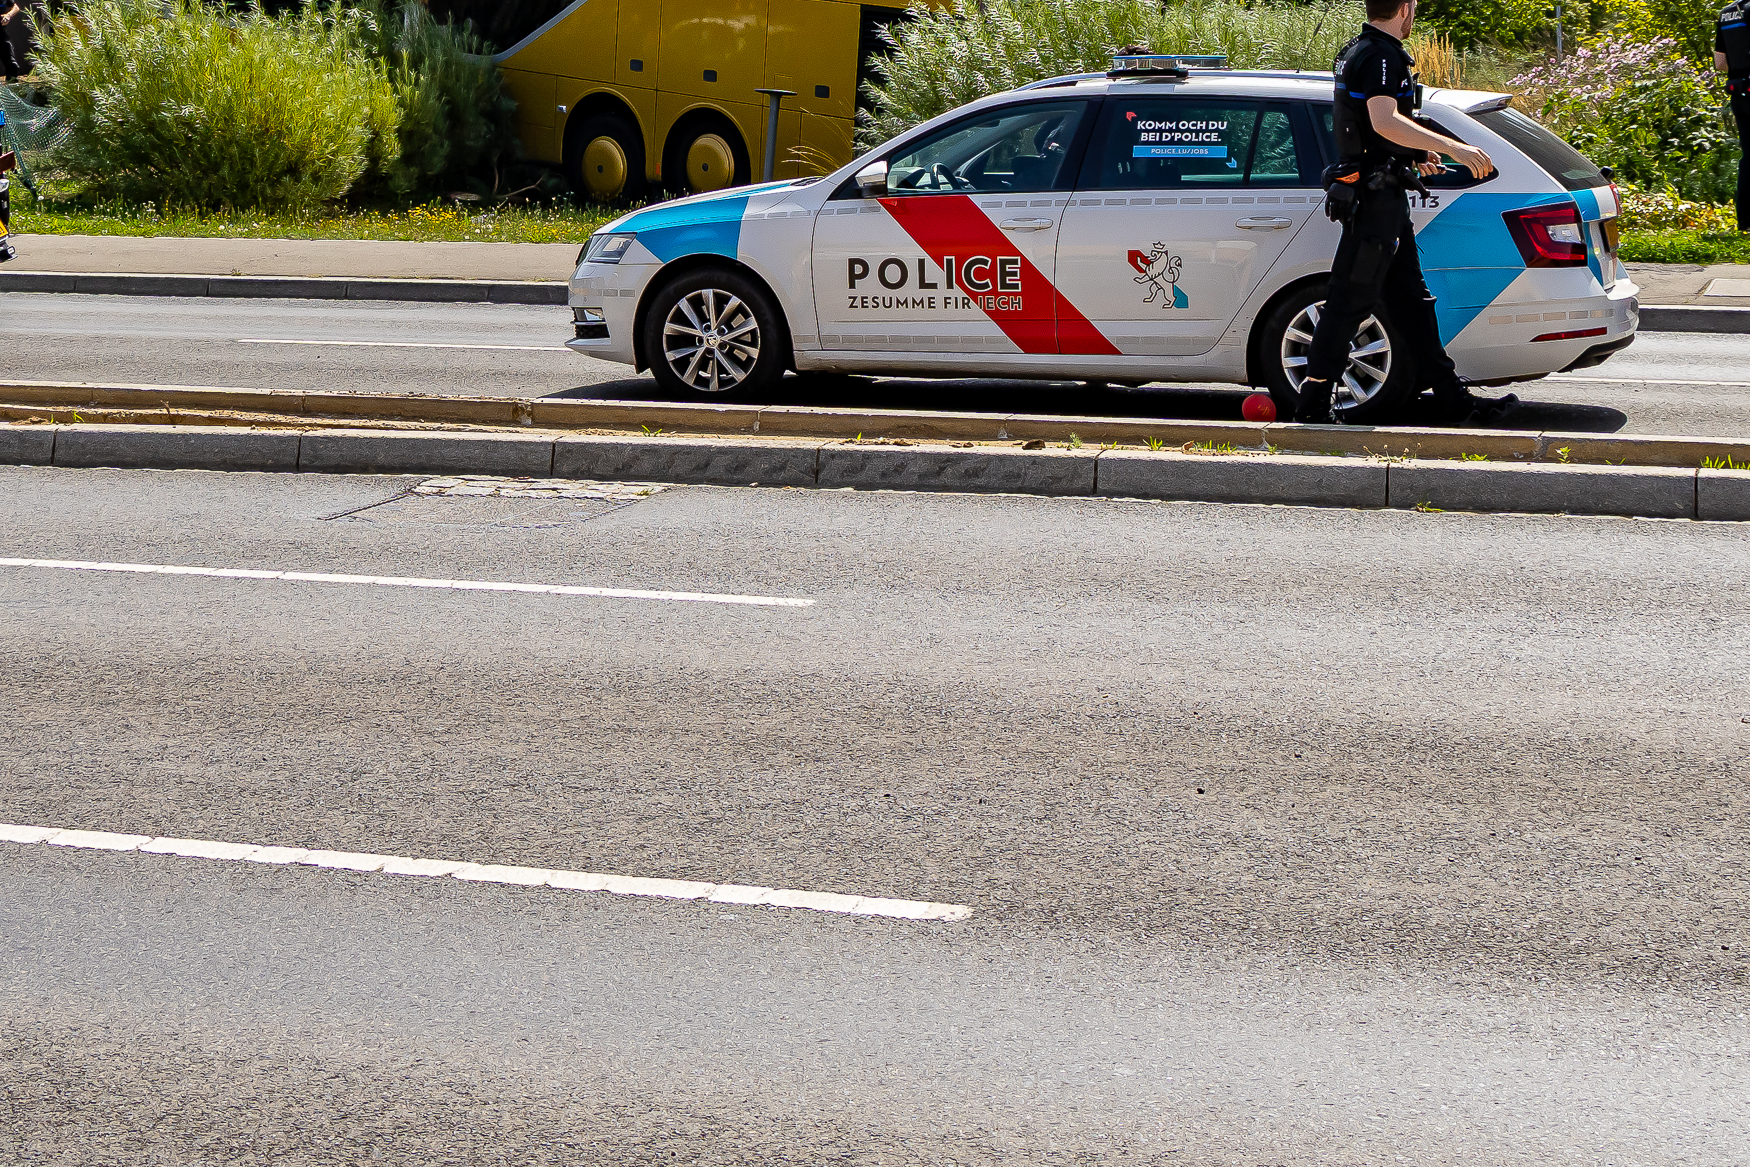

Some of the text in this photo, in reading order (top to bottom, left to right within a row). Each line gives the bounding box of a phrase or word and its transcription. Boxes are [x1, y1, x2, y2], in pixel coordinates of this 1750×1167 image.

[1136, 120, 1228, 130] KOMM OCH DU
[1140, 132, 1222, 142] BEI D'POLICE.
[1409, 195, 1440, 209] 113
[848, 256, 1022, 292] POLICE
[848, 296, 1023, 310] ZESUMME FIR IECH
